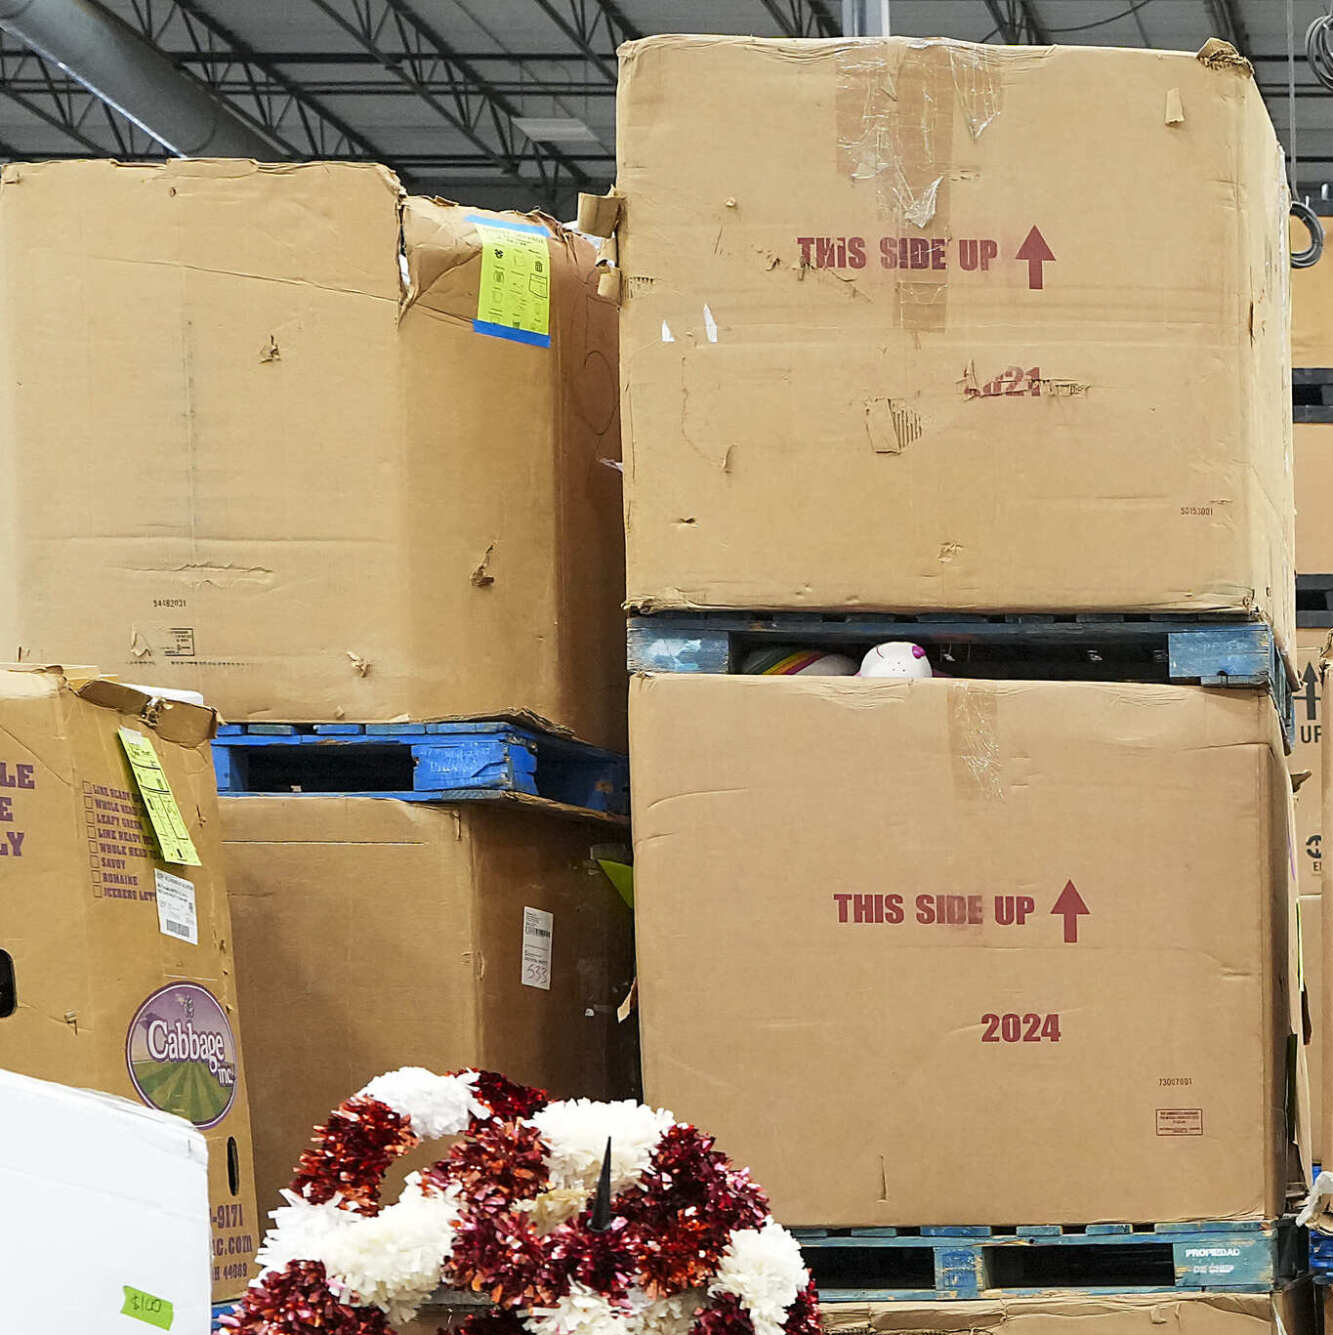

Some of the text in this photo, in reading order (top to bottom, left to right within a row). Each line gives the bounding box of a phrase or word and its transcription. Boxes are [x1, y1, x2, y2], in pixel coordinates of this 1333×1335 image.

[797, 236, 998, 271] THIS SIDE UP
[833, 893, 1035, 926] THIS SIDE UP
[980, 1013, 1062, 1043] 2024
[147, 1019, 225, 1073] Cabbage
